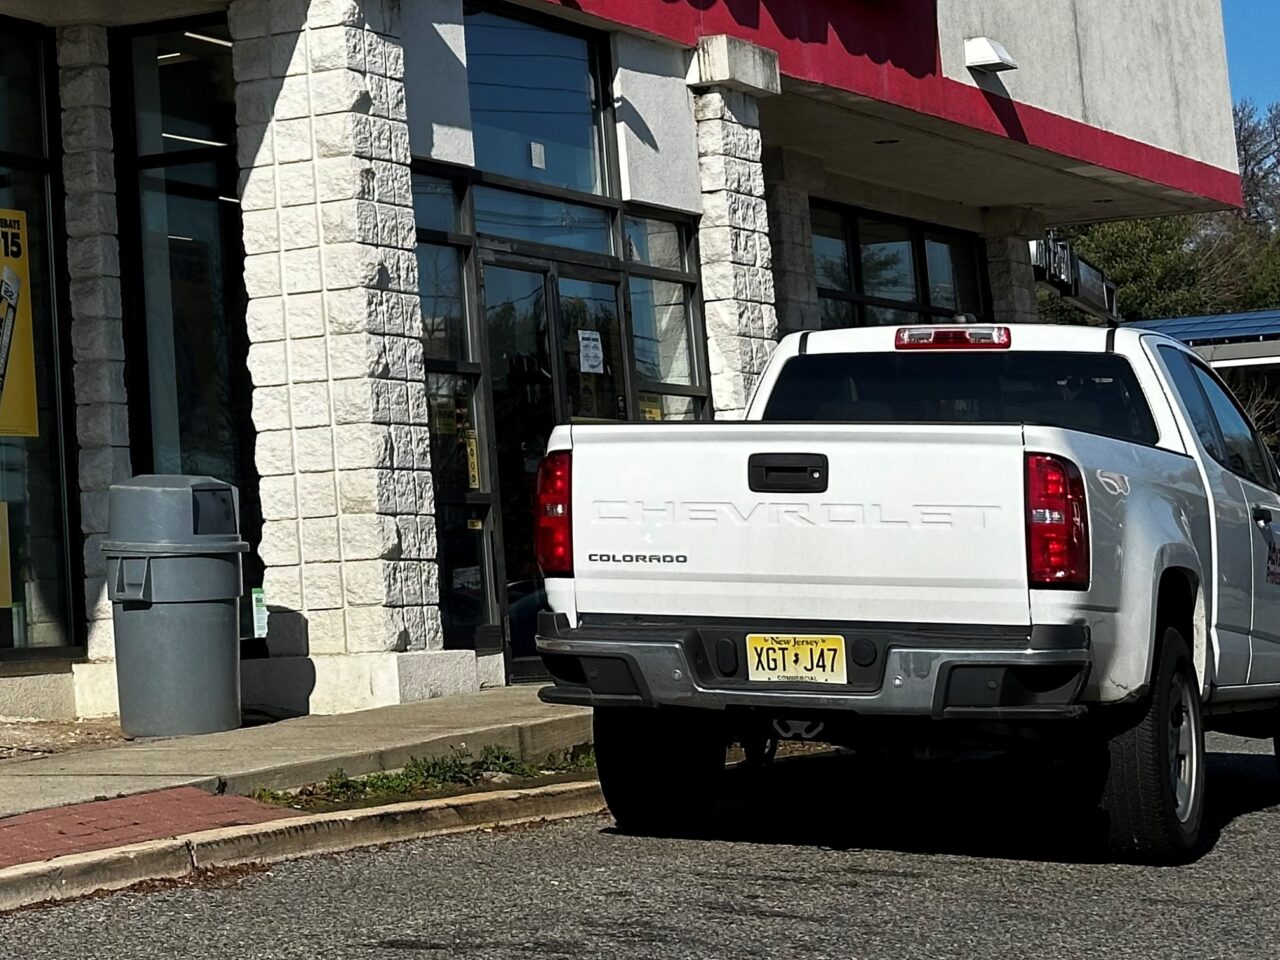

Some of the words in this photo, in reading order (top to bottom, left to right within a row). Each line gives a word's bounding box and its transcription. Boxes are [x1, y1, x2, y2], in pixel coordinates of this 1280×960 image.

[590, 499, 1003, 530] CHEVROLET
[588, 553, 688, 564] COLORADO
[770, 637, 791, 646] New
[792, 637, 820, 647] Jersey
[754, 646, 788, 672] XGT
[803, 647, 838, 673] J47
[776, 674, 818, 682] COMMERCIAL
